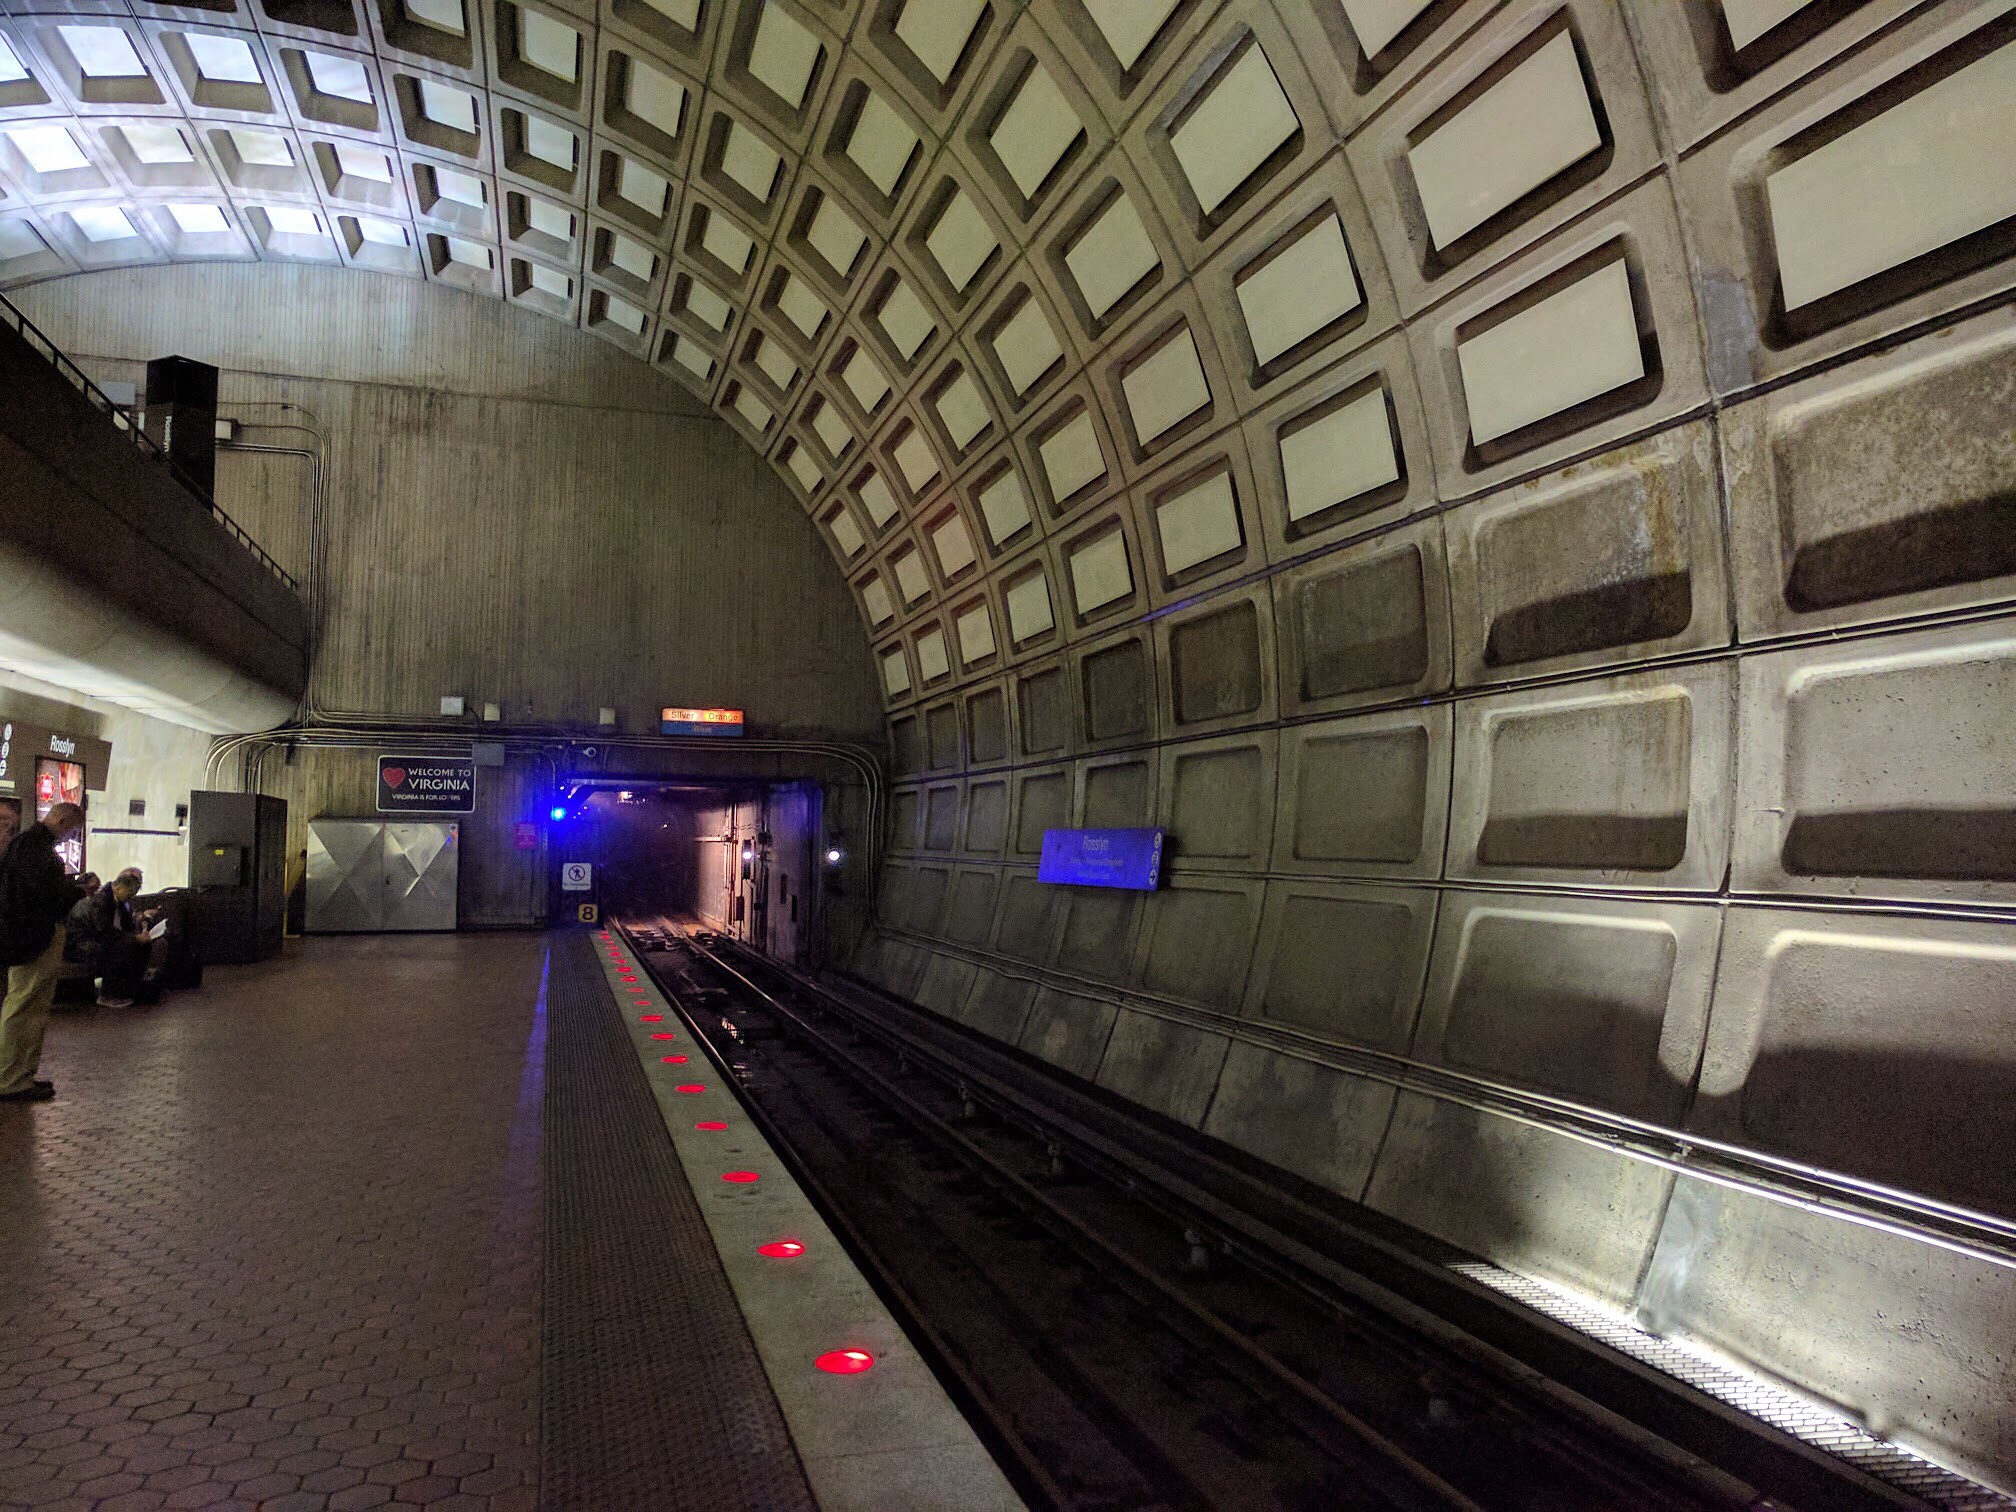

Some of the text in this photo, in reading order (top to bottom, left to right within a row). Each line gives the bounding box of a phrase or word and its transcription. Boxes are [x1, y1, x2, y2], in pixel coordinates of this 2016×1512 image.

[671, 711, 738, 722] Silver Orange
[50, 735, 75, 758] Rosslyn
[408, 768, 471, 777] WELCOME TO
[408, 778, 470, 791] VIRGINIA
[1082, 835, 1109, 854] Rosslyn
[582, 906, 594, 920] 8
